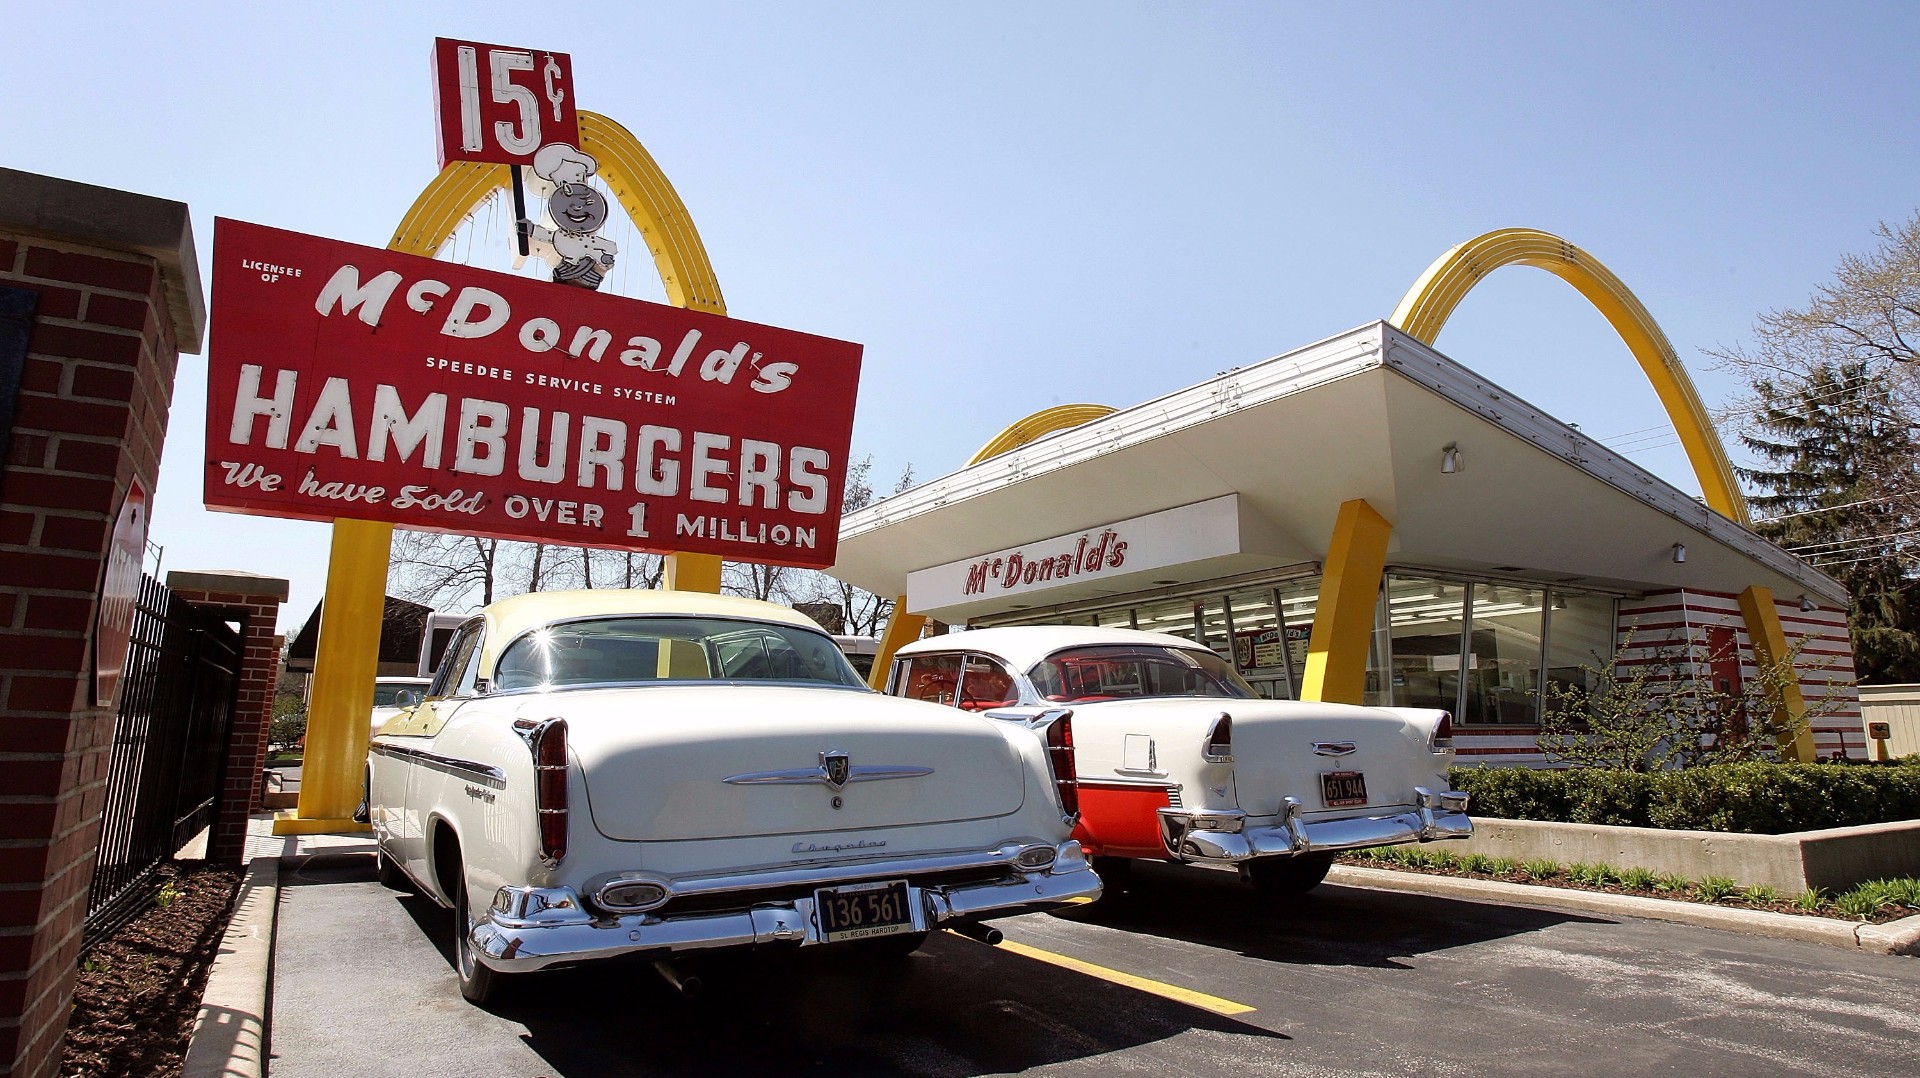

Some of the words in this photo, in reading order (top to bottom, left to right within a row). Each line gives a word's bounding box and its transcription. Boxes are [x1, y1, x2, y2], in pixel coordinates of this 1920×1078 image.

[242, 259, 302, 278] LICENSEE
[261, 273, 279, 283] OF
[315, 264, 800, 394] McDonald's
[426, 357, 513, 380] SPEEDEE
[525, 373, 602, 395] SERVICE
[613, 387, 676, 406] SYSTEM
[229, 363, 829, 515] HAMBURGERS
[220, 461, 282, 492] We
[299, 469, 387, 504] have
[391, 485, 486, 516] Sold
[504, 494, 605, 528] OVER
[626, 501, 650, 539] 1
[676, 513, 817, 550] MILLION
[103, 543, 139, 633] STOP
[963, 528, 1128, 596] McDonald's
[827, 897, 862, 928] 136
[868, 892, 902, 922] 561
[850, 929, 869, 938] REGIS
[871, 925, 899, 935] HARDTOP
